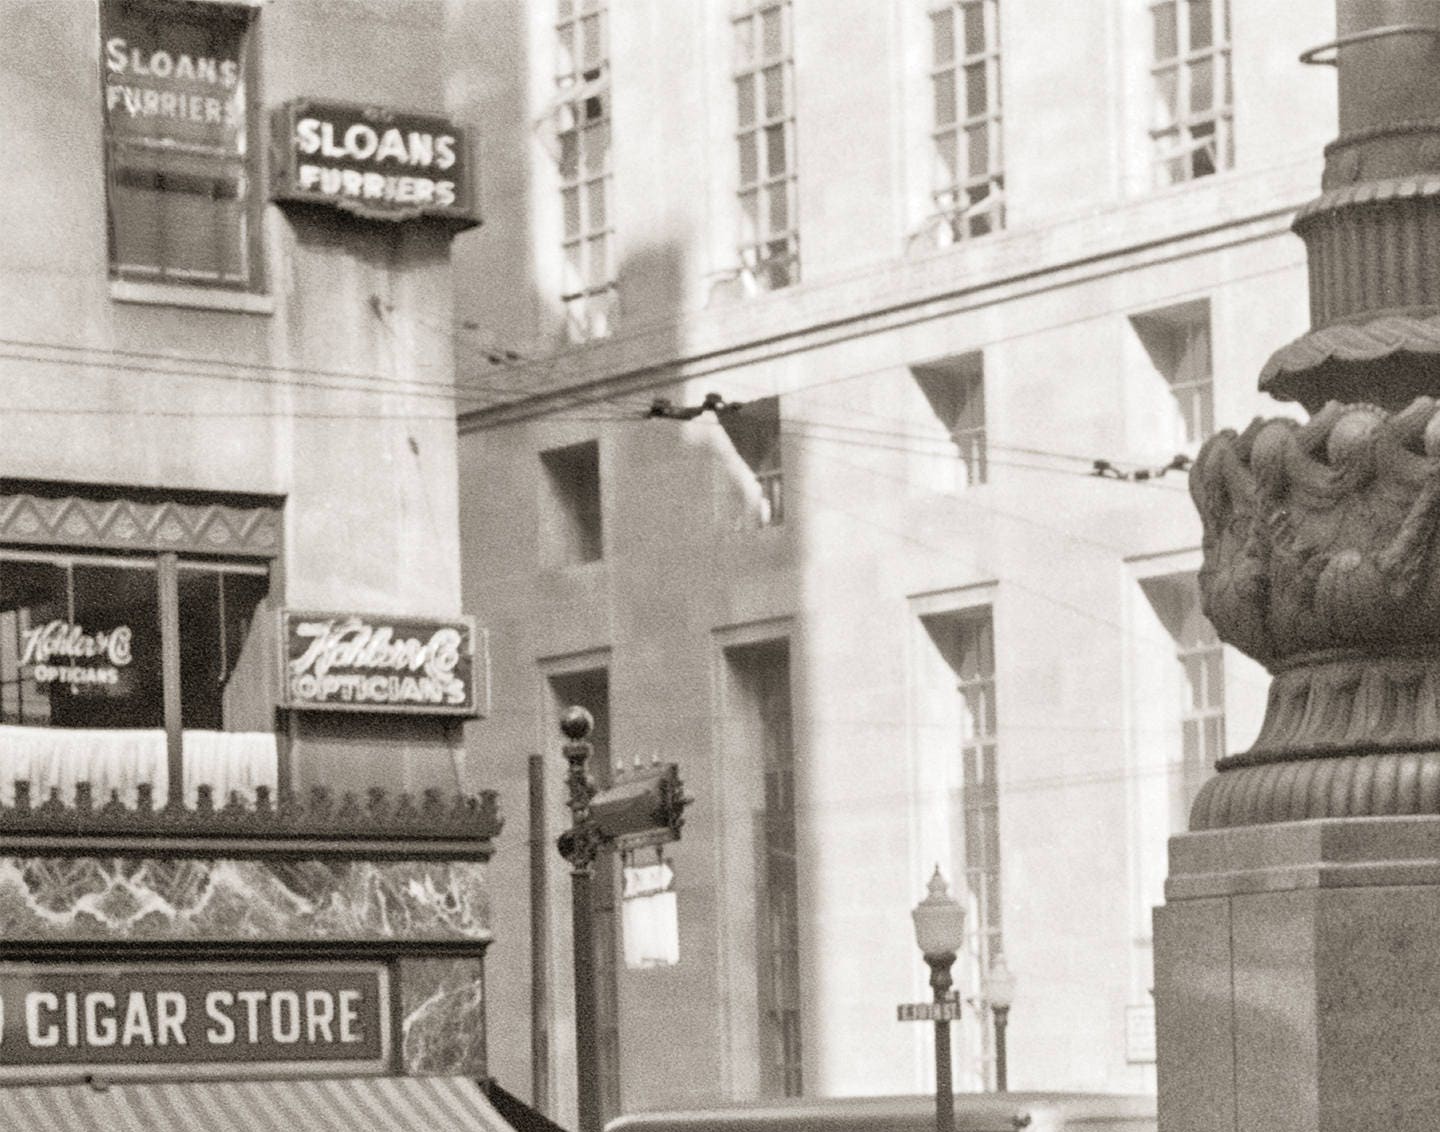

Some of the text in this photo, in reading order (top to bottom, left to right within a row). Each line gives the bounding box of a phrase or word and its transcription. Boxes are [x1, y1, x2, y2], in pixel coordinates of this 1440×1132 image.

[106, 38, 238, 89] SLOANS
[297, 118, 456, 170] SLOANS
[299, 165, 456, 207] FURRIERS
[34, 665, 119, 685] OPTICIANS
[292, 675, 466, 704] OPTICIANS
[25, 991, 188, 1047] CIGAR
[205, 990, 362, 1044] STORE
